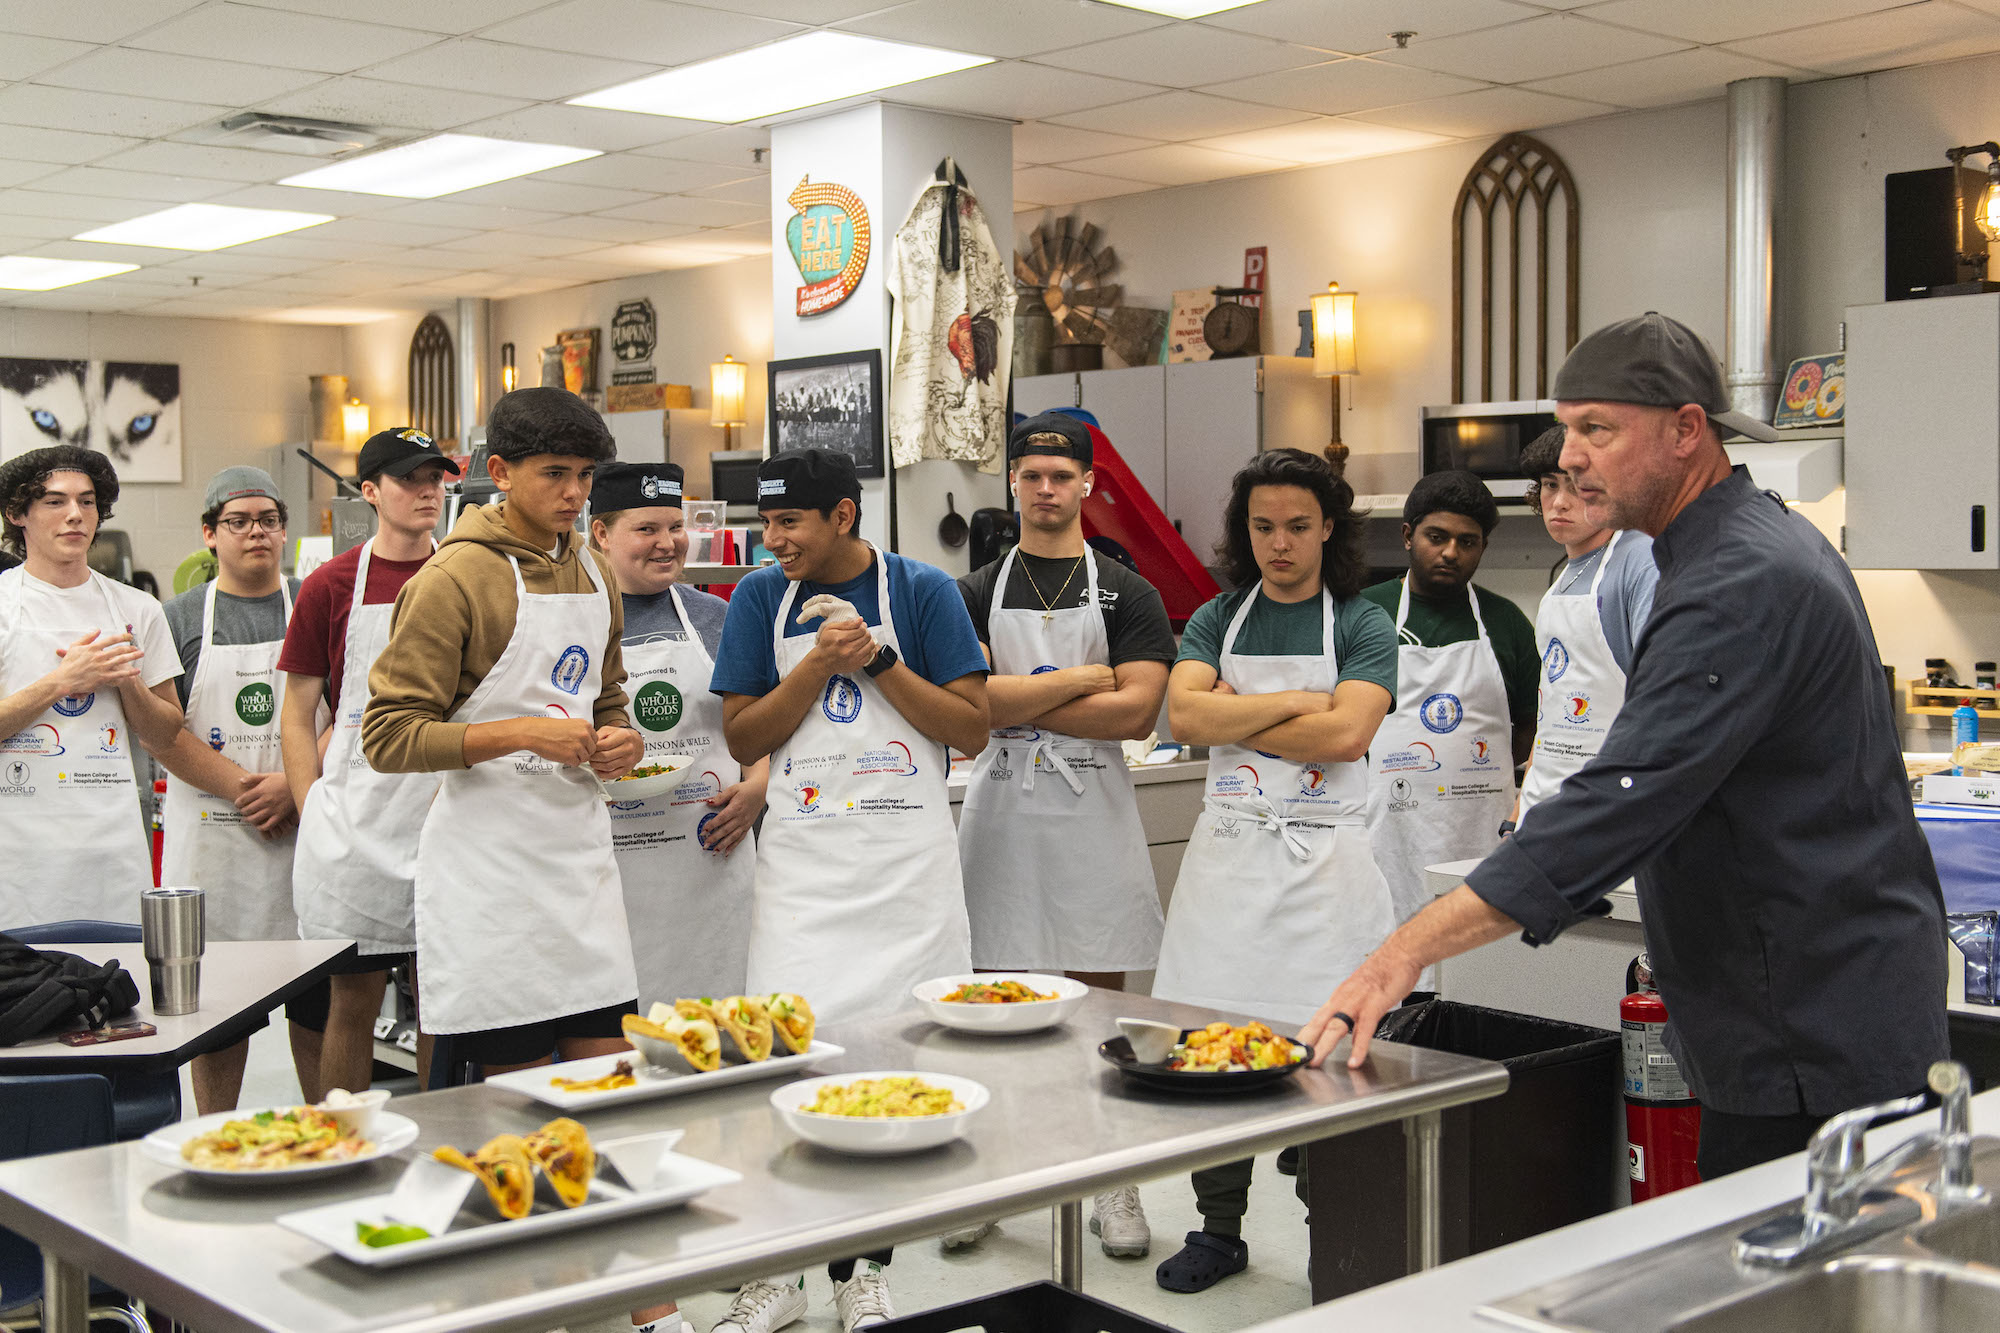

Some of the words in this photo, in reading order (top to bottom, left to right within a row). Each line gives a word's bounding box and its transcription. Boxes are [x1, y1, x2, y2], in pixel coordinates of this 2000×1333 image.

[802, 214, 846, 251] EAT
[800, 249, 842, 272] HERE
[800, 286, 844, 312] HOMEMADE
[613, 323, 652, 346] PUMPKINS
[630, 668, 668, 678] Sponsored
[241, 693, 273, 705] WHOLE
[639, 692, 679, 707] WHOLE
[1566, 691, 1590, 702] KEISER
[242, 703, 273, 713] FOODS
[642, 704, 679, 717] FOODS
[228, 733, 272, 744] JOHNSON
[686, 737, 710, 746] WALES
[793, 757, 820, 767] JOHNSON
[1382, 756, 1420, 764] RESTAURANT
[515, 763, 553, 771] WORLD
[1302, 763, 1326, 774] KEISER
[675, 786, 711, 795] RESTAURANT
[794, 780, 821, 792] KEISER
[1387, 801, 1418, 810] WORLD
[614, 839, 646, 847] Hospitality
[648, 835, 686, 844] Management
